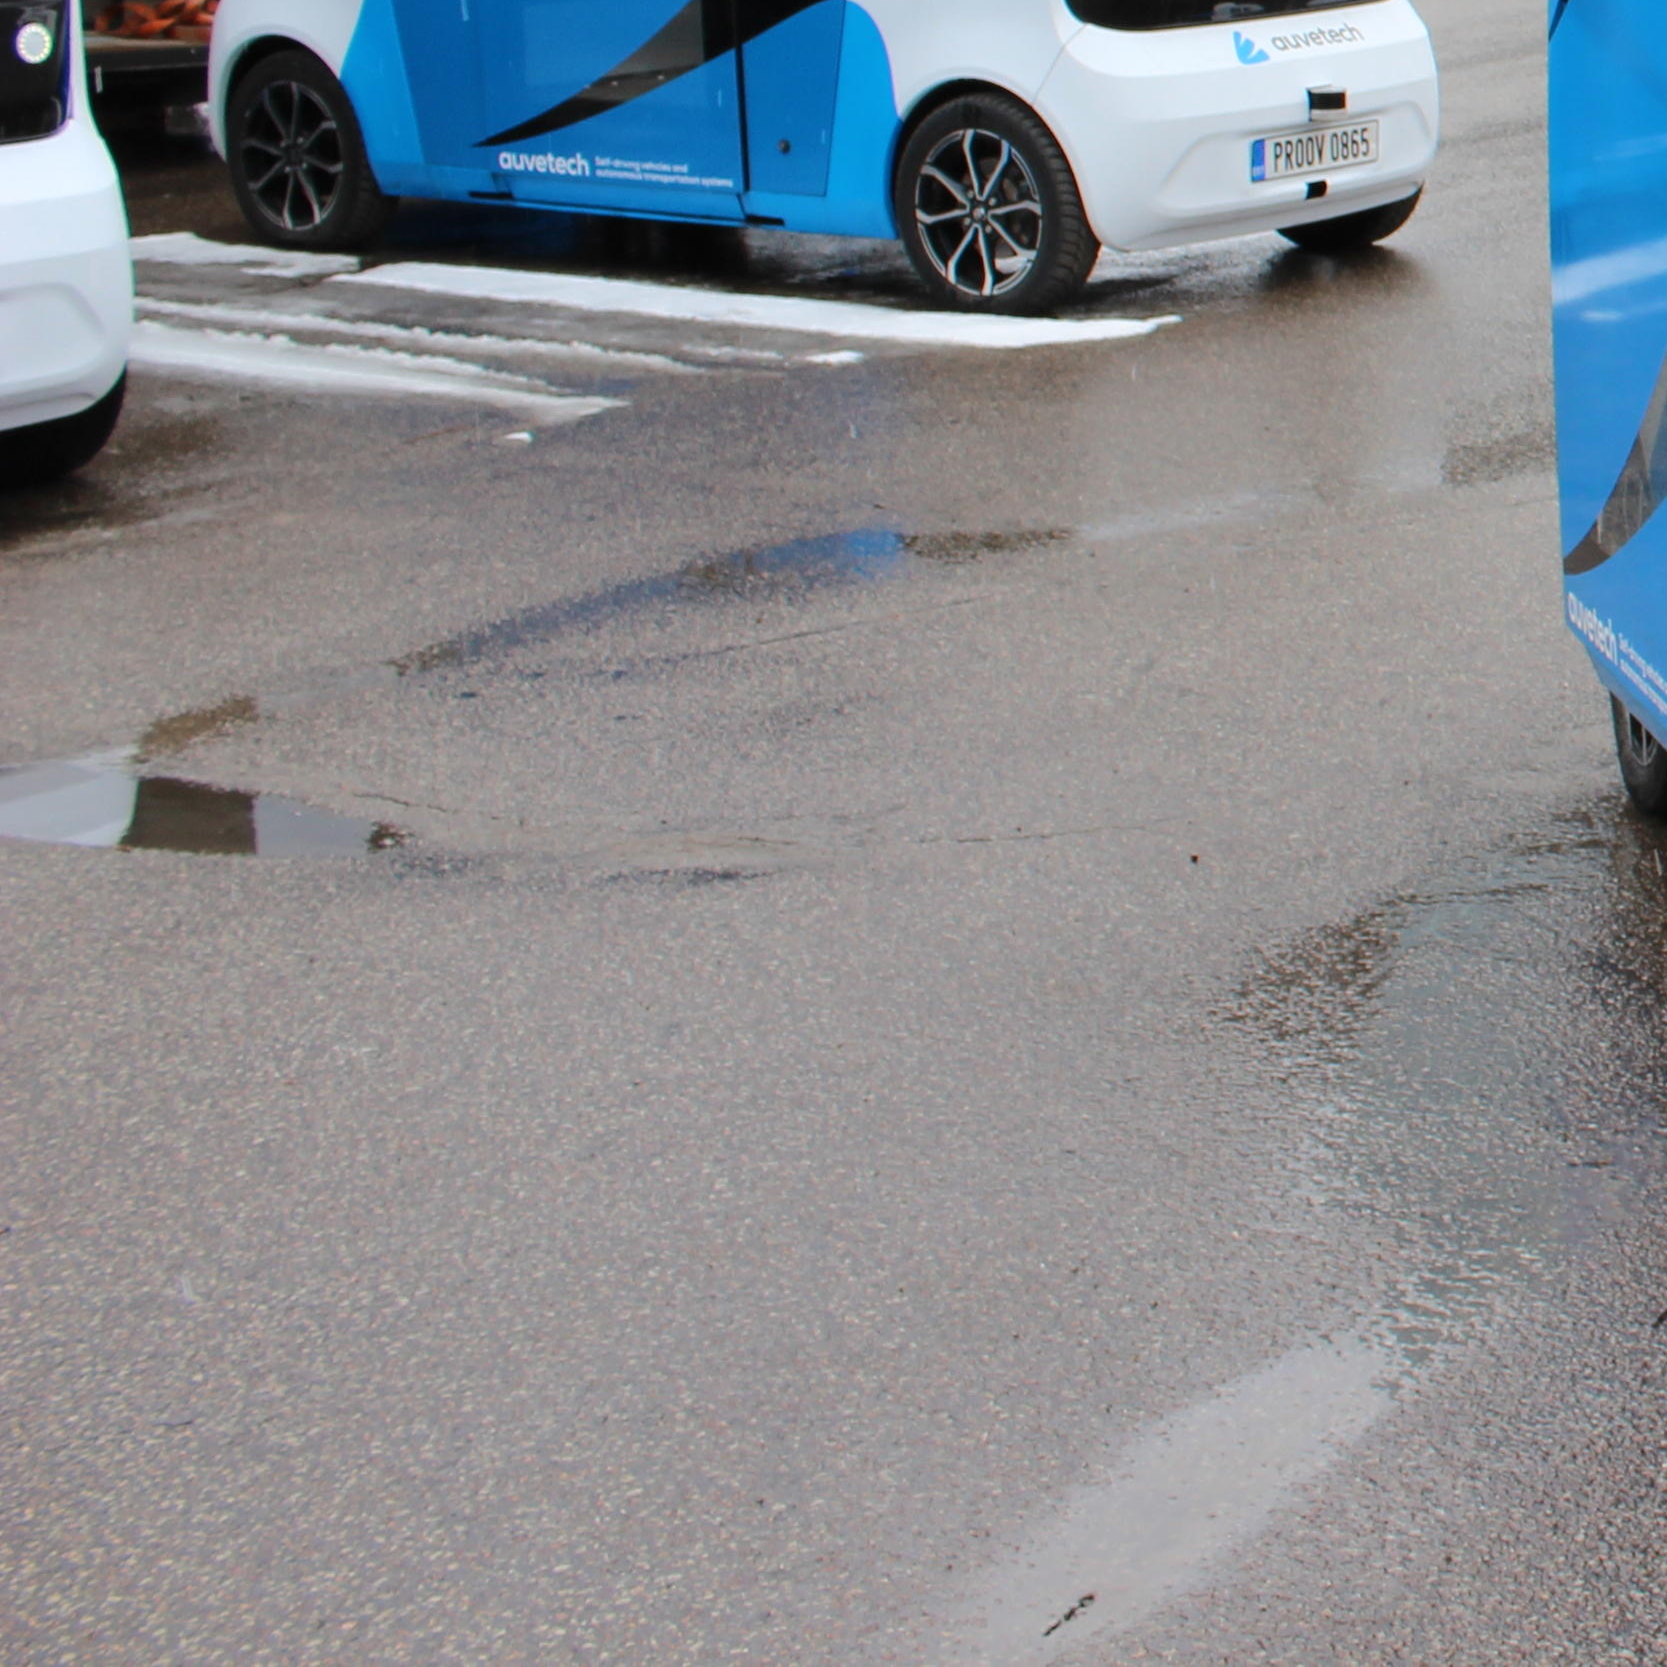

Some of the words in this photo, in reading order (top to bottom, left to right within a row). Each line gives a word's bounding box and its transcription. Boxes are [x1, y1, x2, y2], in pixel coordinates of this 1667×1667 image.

[1270, 22, 1365, 52] auvetech
[498, 151, 590, 177] auvetech
[1273, 134, 1326, 173] PROOV
[1330, 127, 1370, 162] 0865
[1567, 591, 1618, 665] auvetech
